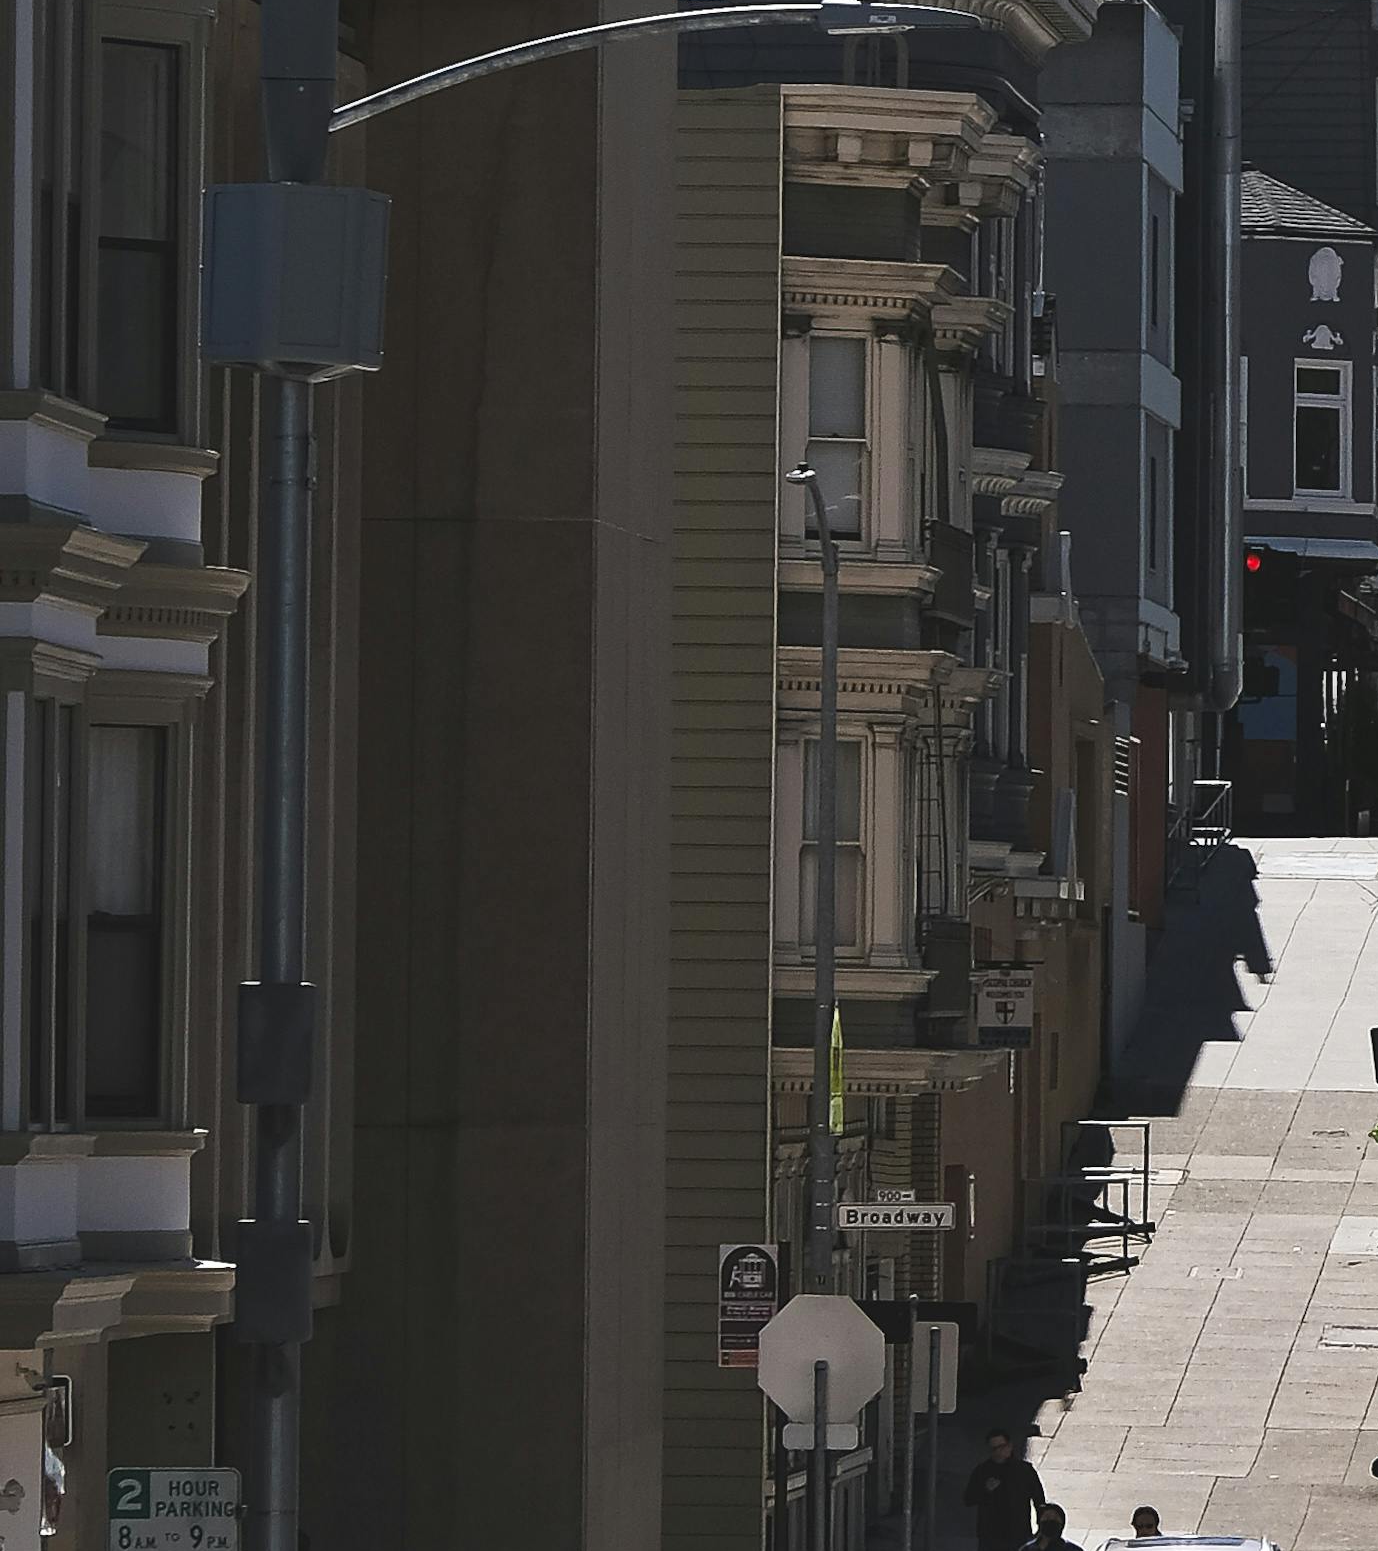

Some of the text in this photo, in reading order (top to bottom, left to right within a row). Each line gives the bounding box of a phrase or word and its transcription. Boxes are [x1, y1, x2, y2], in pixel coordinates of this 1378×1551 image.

[846, 1209, 945, 1227] Broadway
[117, 1479, 142, 1510] 2
[169, 1480, 220, 1497] HOUR
[155, 1501, 234, 1517] PARKING
[118, 1526, 131, 1549] 8
[165, 1532, 181, 1542] TO
[190, 1525, 203, 1549] 9
